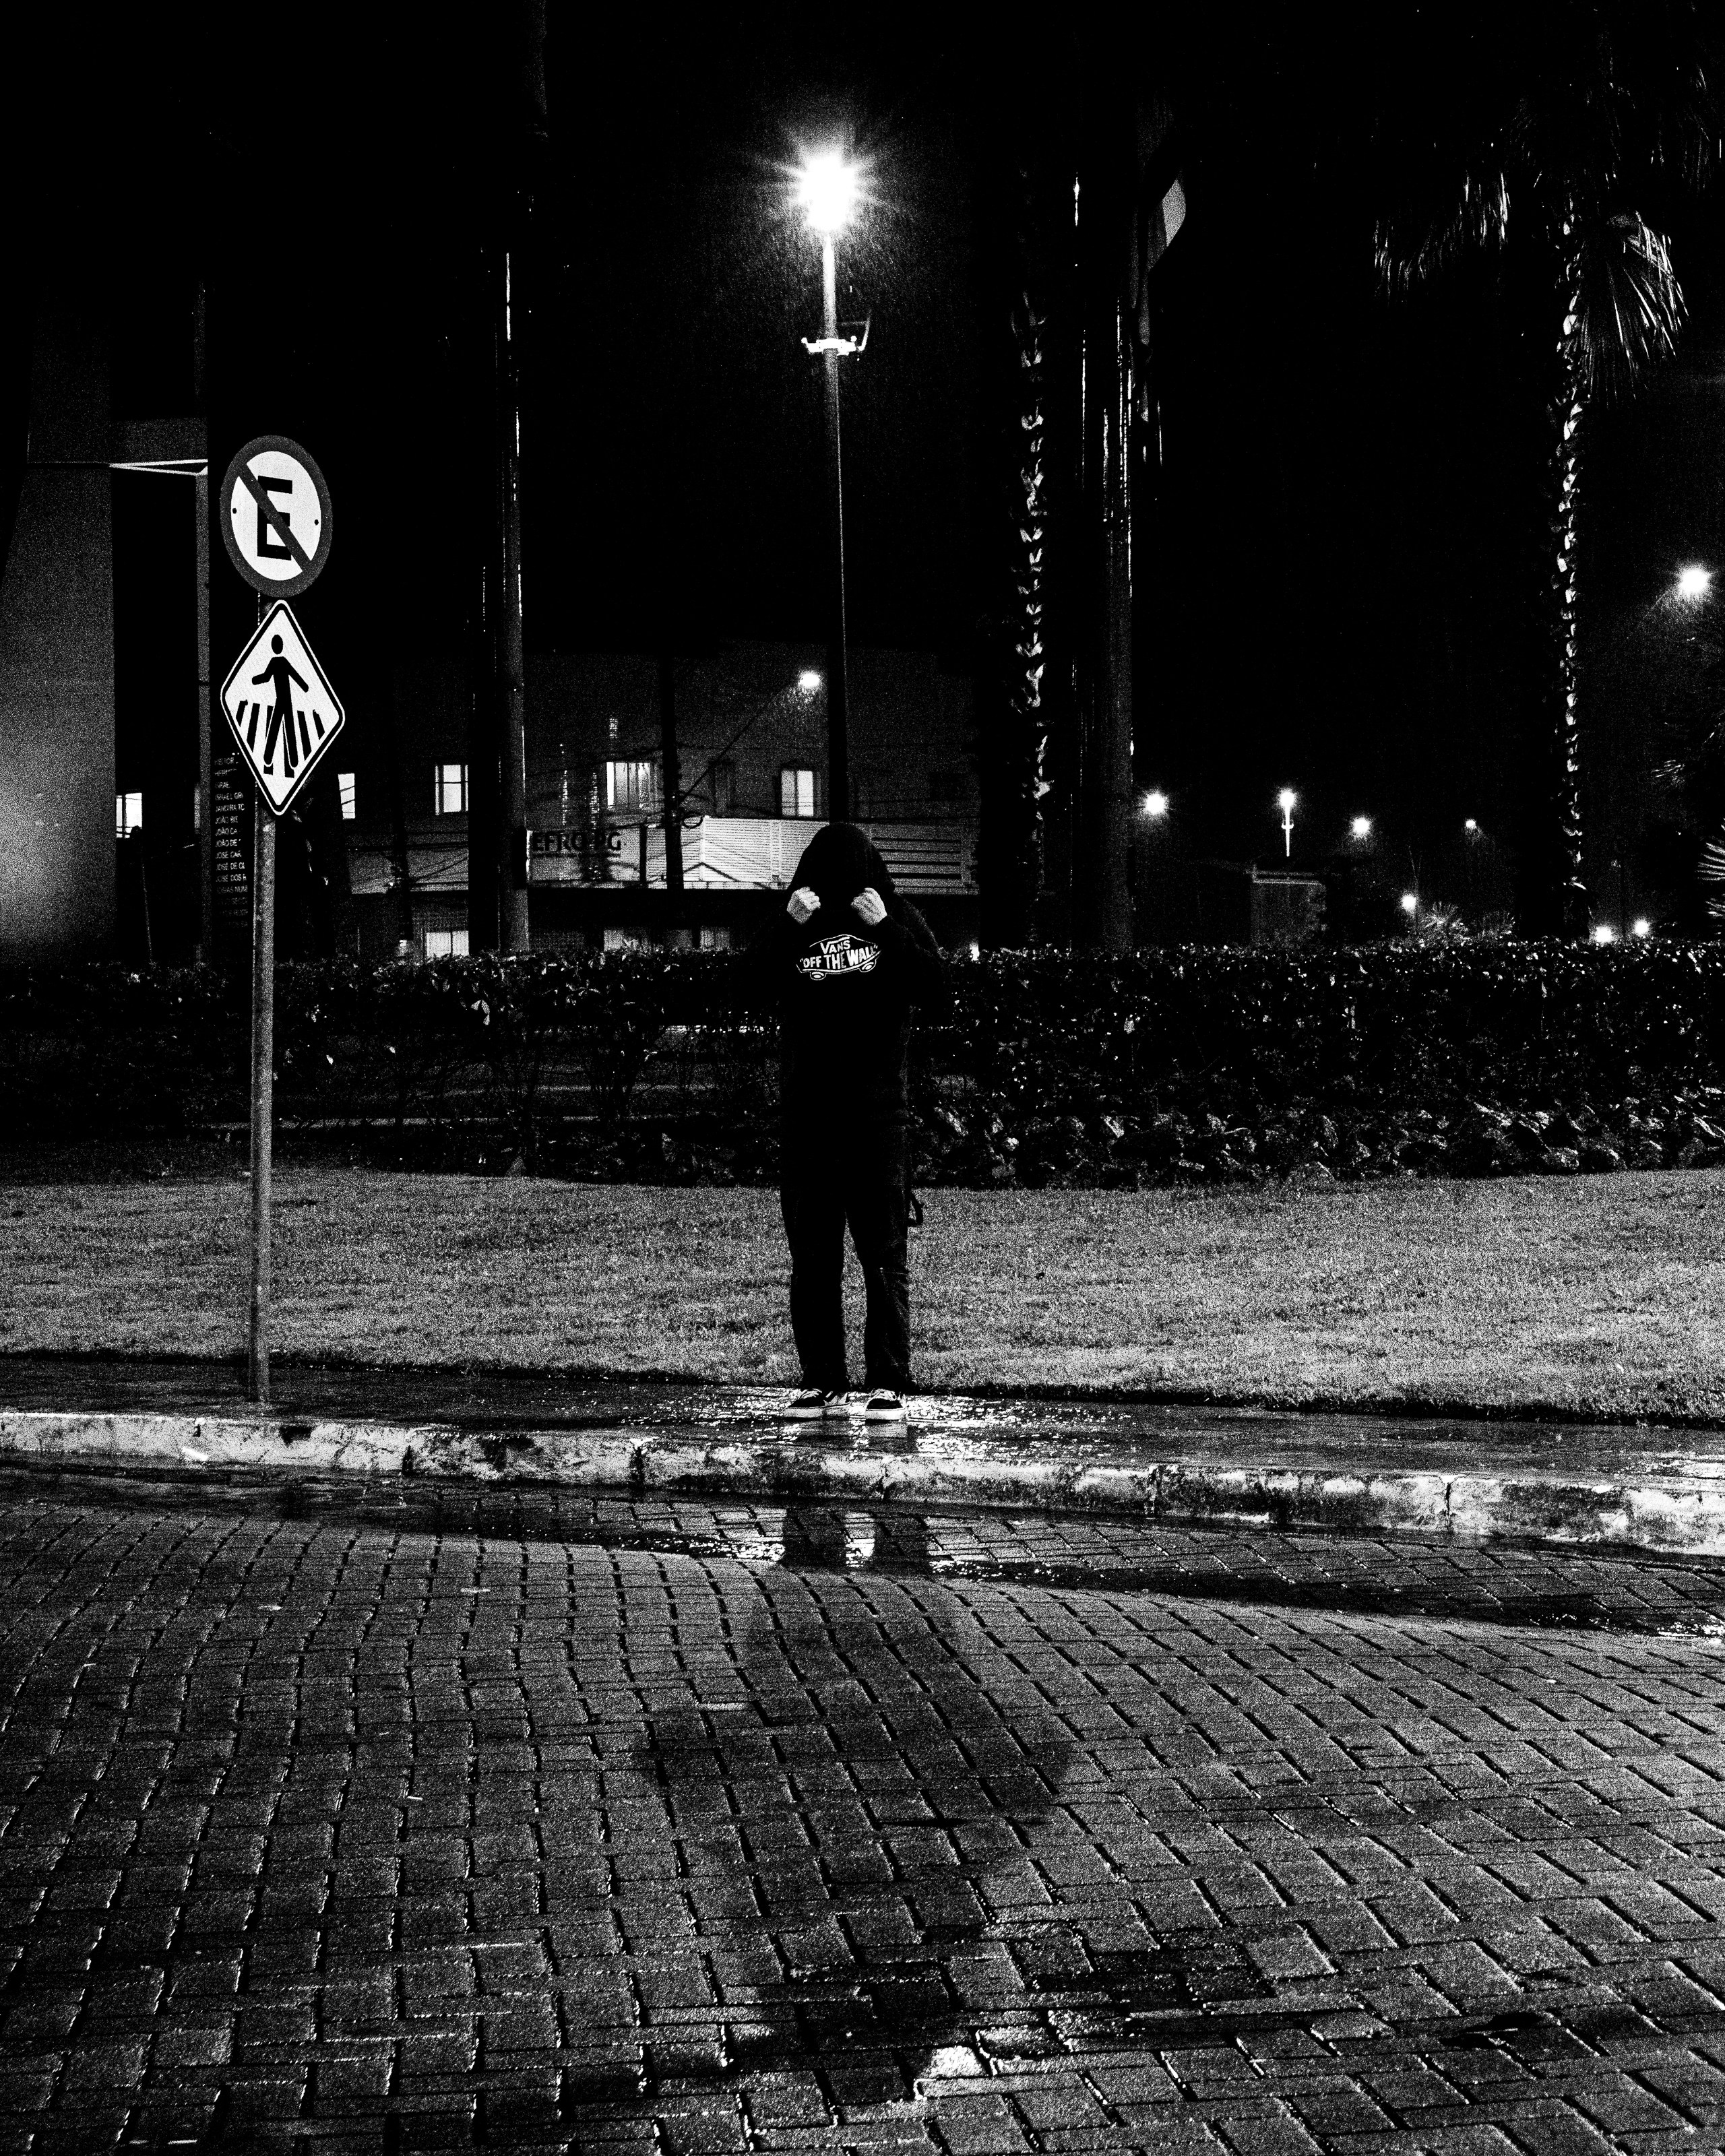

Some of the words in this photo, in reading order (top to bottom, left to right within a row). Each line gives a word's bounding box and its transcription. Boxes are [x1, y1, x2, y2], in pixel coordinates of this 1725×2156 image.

[257, 476, 293, 561] E
[819, 936, 851, 955] VANS
[823, 951, 847, 970] THE
